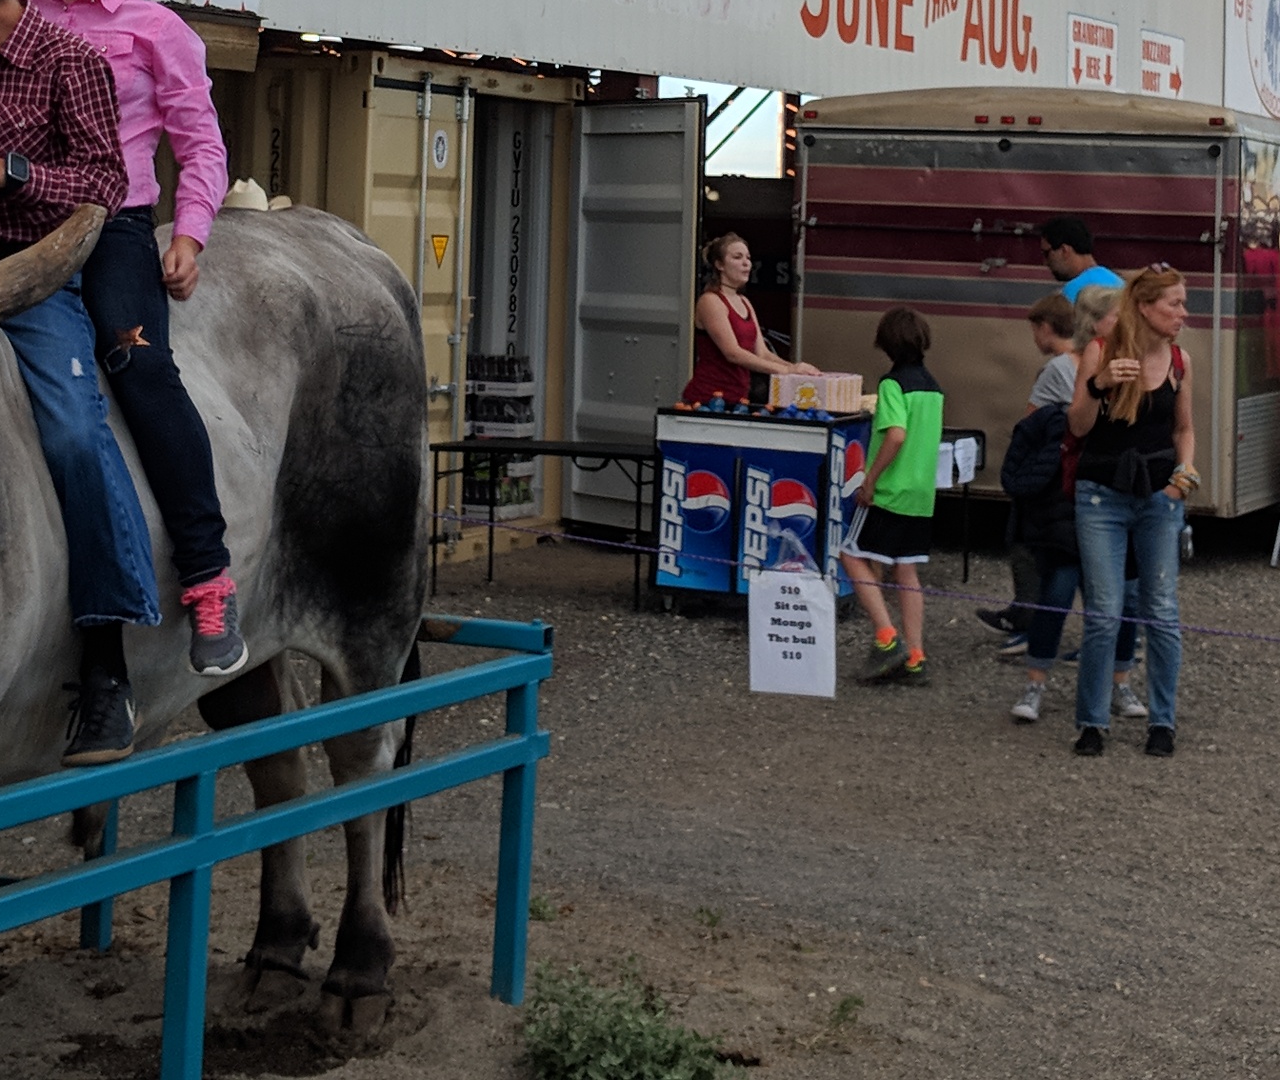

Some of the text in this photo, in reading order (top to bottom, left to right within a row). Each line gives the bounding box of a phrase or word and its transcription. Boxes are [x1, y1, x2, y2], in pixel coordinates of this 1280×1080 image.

[1073, 20, 1114, 50] GRANDSTAND
[1086, 56, 1101, 80] HERE
[511, 130, 522, 208] GVTU
[507, 215, 521, 333] 230982
[658, 459, 687, 578] PEPSI
[781, 585, 801, 595] $10
[775, 601, 790, 611] Sit
[770, 617, 812, 630] Mongo
[768, 633, 817, 645] The bull
[782, 651, 802, 660] $10
